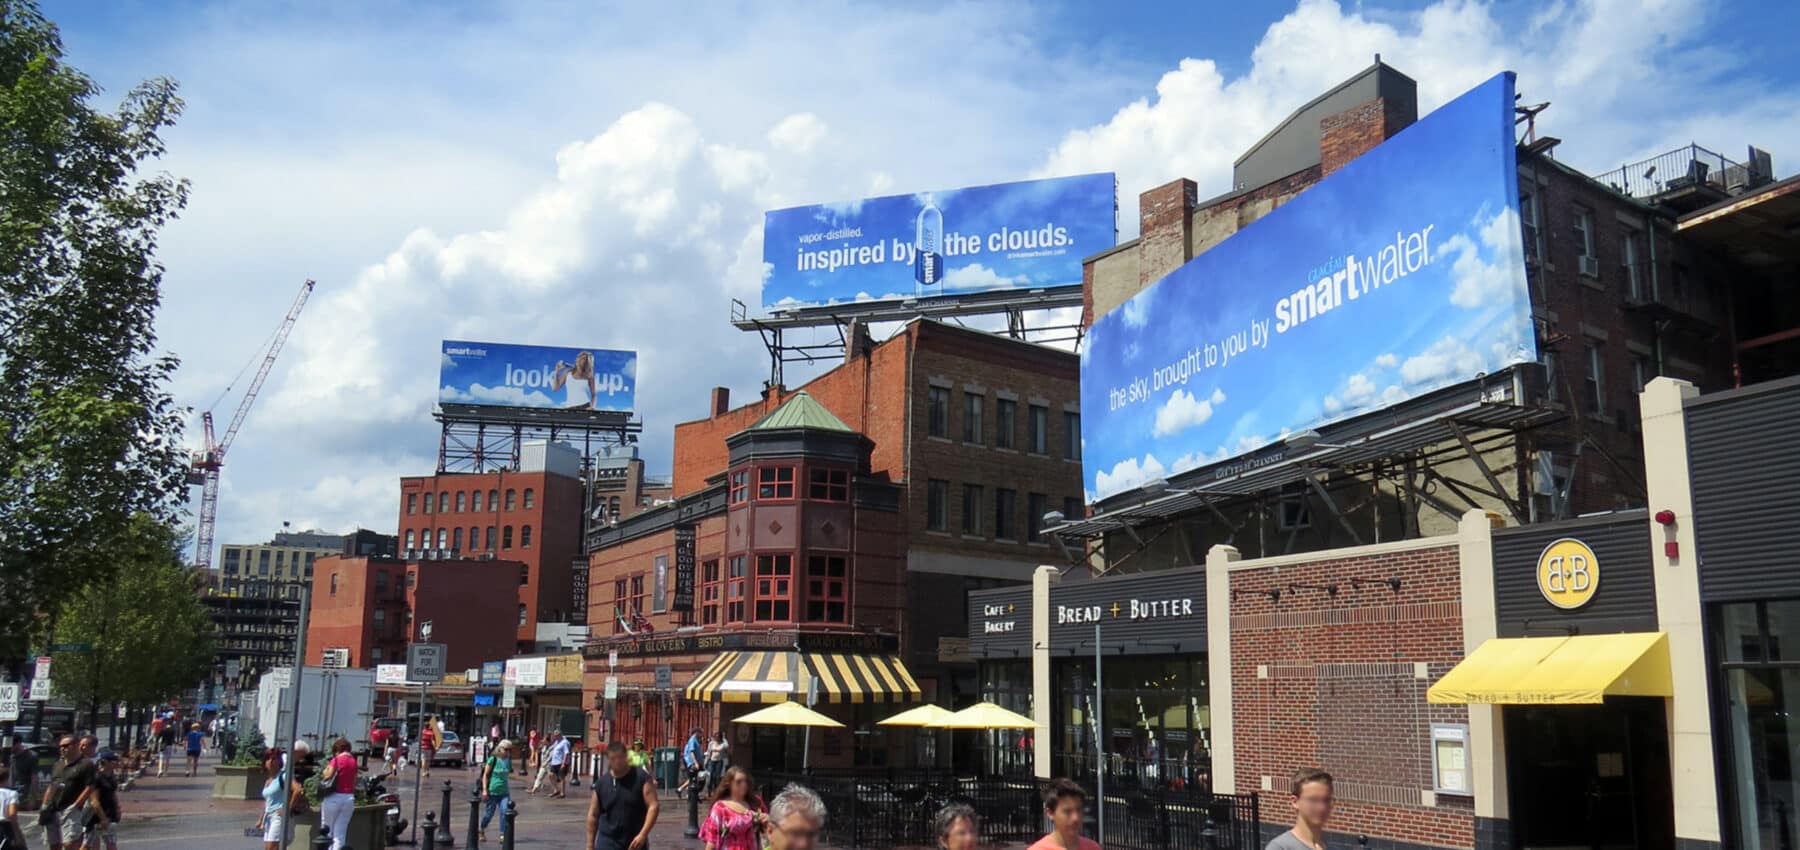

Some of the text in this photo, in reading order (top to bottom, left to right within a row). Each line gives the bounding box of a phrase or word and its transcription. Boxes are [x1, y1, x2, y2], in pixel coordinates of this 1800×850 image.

[944, 232, 981, 256] the
[988, 222, 1074, 252] clouds.
[797, 239, 885, 273] inspired
[892, 237, 917, 266] by
[1109, 387, 1127, 411] the
[1129, 375, 1150, 402] sky,
[1153, 347, 1201, 392] brought
[1203, 343, 1217, 368] to
[1221, 330, 1247, 367] you
[1251, 318, 1269, 349] by
[505, 363, 630, 397] look up.
[984, 604, 1004, 617] CAFE
[1058, 605, 1101, 624] BREAD
[1130, 599, 1192, 619] BUTTER
[984, 621, 1015, 634] BAKERY
[698, 636, 724, 648] BISTRO
[0, 686, 13, 700] NO
[0, 702, 16, 713] USES
